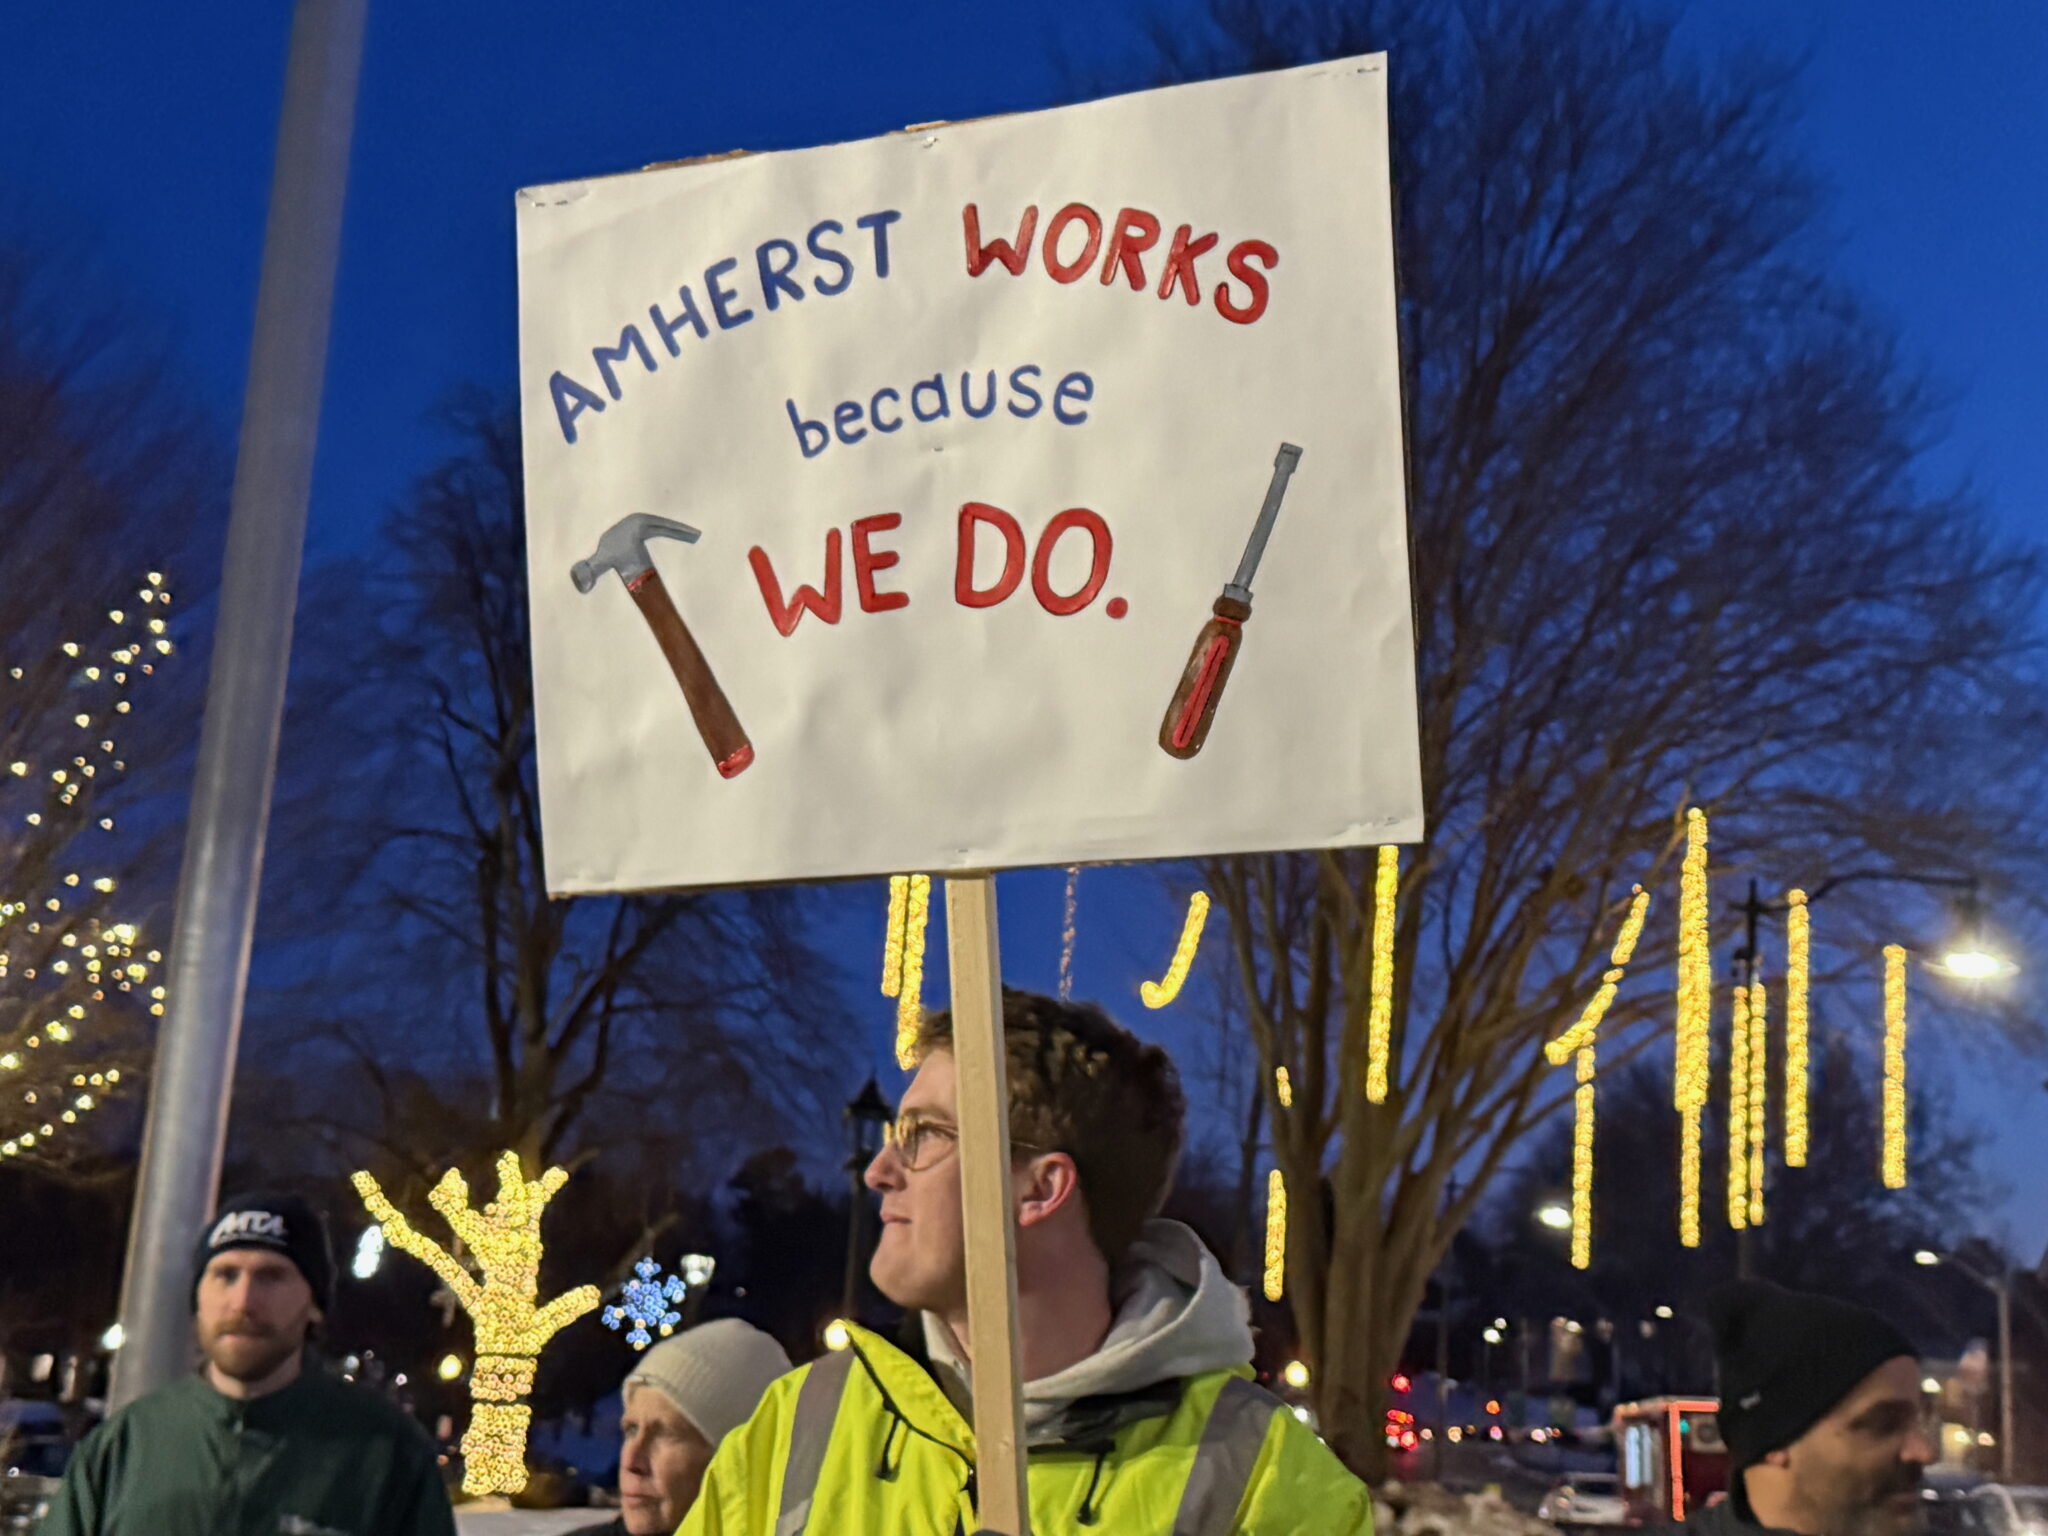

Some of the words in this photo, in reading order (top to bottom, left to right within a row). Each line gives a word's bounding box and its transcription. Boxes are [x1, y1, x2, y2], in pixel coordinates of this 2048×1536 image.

[549, 209, 902, 443] AMHERST
[964, 203, 1279, 324] WORKS
[787, 364, 1096, 459] because
[748, 512, 910, 637] WE
[955, 502, 1129, 620] DO.
